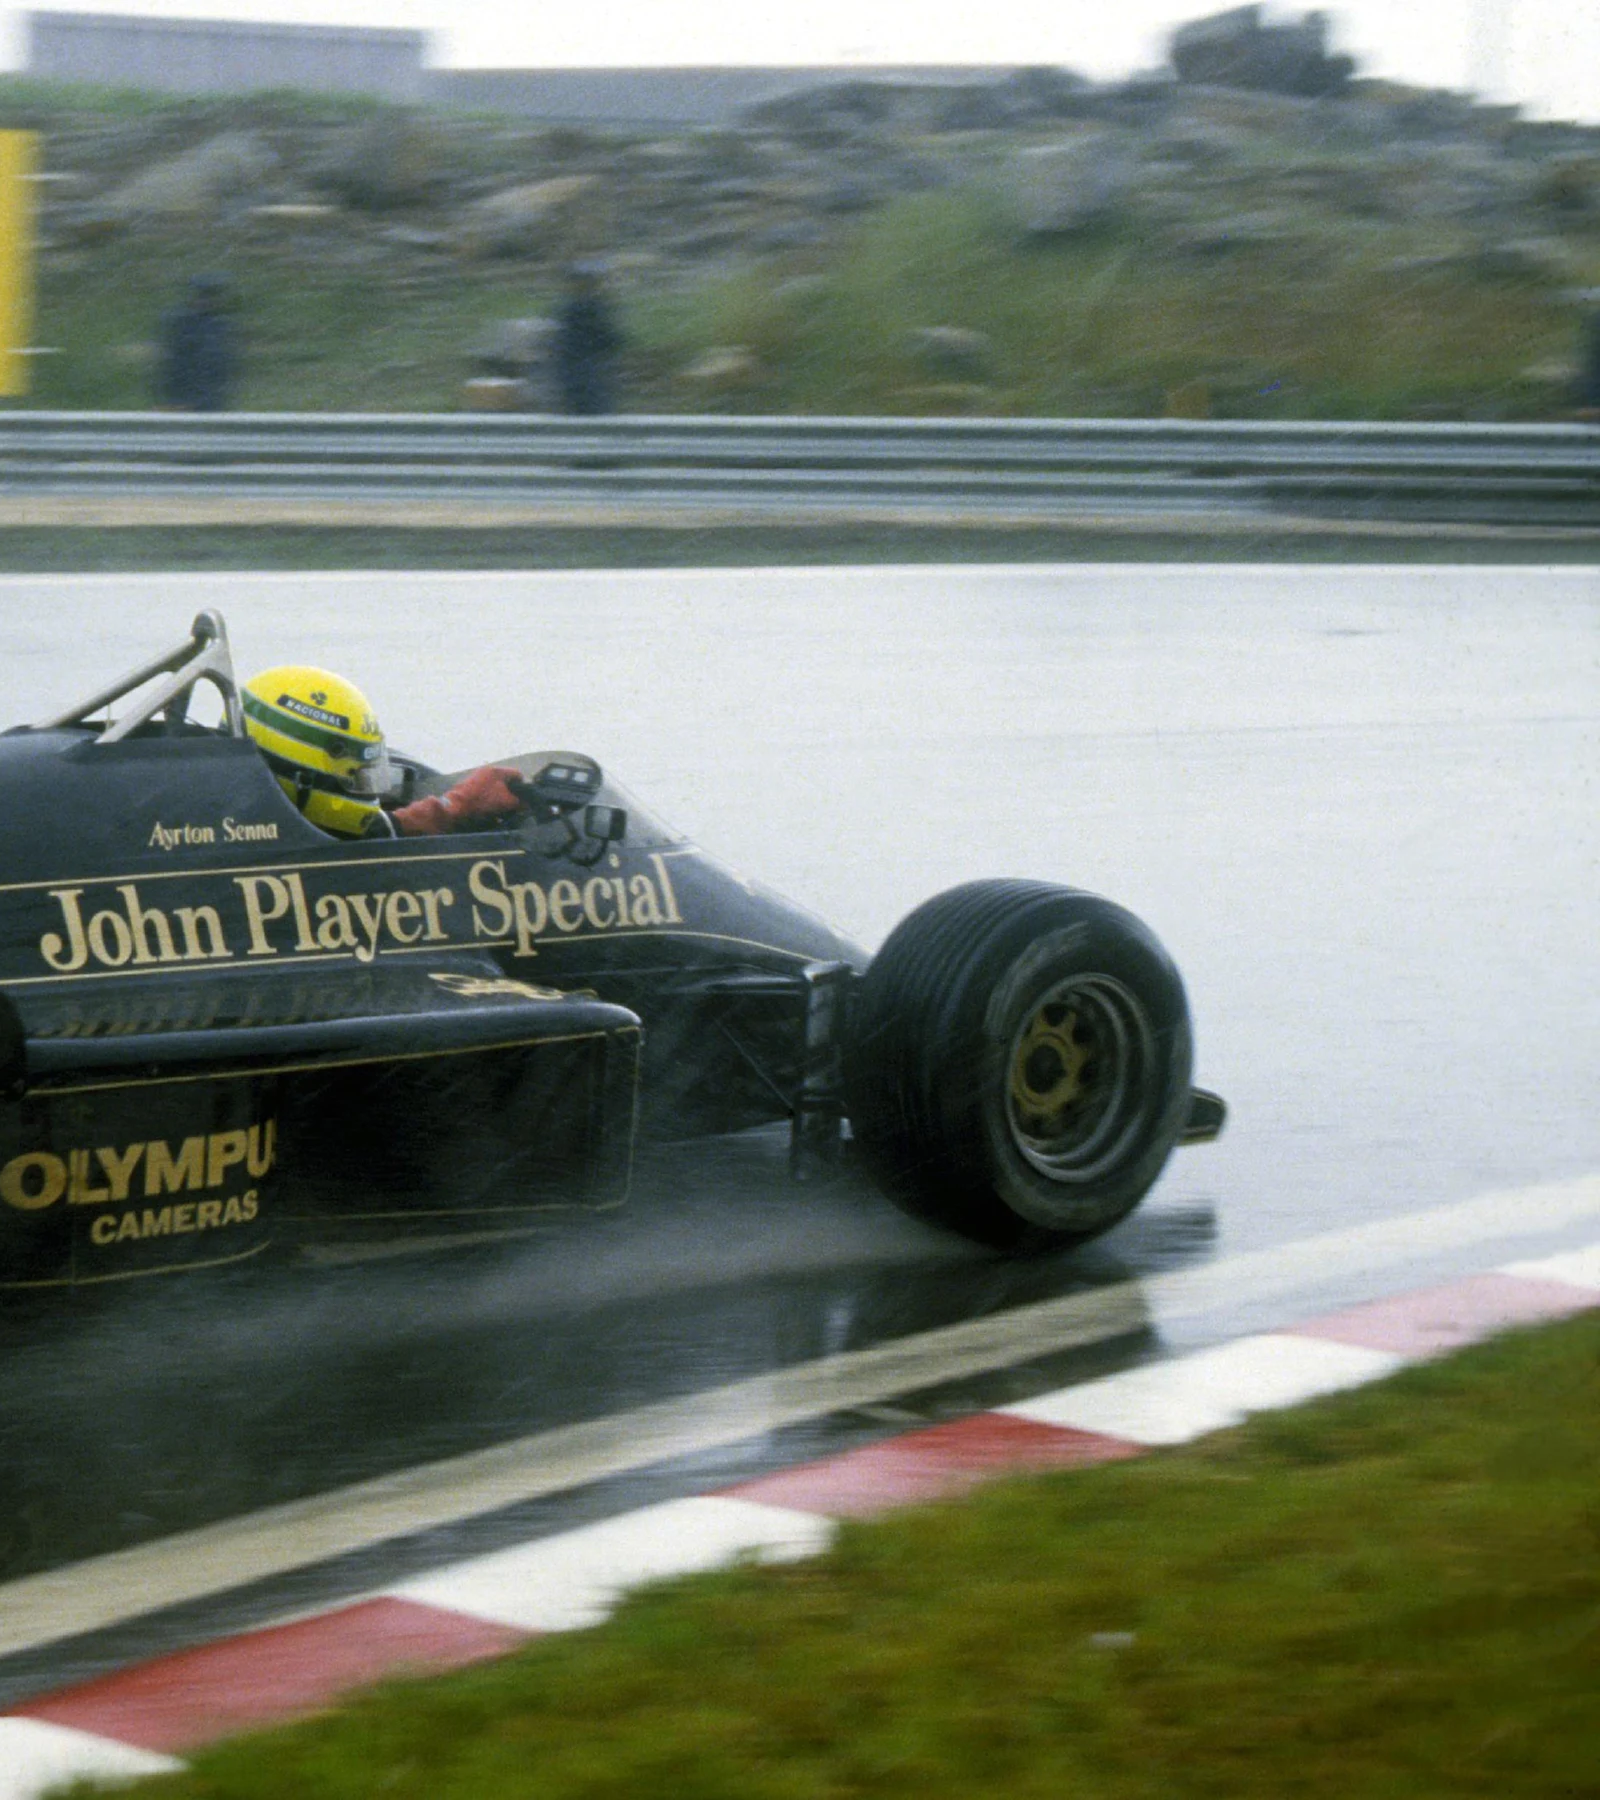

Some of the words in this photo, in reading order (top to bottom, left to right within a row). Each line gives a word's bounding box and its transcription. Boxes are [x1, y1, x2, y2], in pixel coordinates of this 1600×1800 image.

[283, 698, 342, 727] NACIONAL
[149, 820, 215, 851] Ayrton
[222, 816, 278, 842] Senna
[40, 884, 234, 972] John
[234, 872, 454, 962] Player
[468, 853, 684, 957] Special
[90, 1189, 259, 1245] CAMERAS
